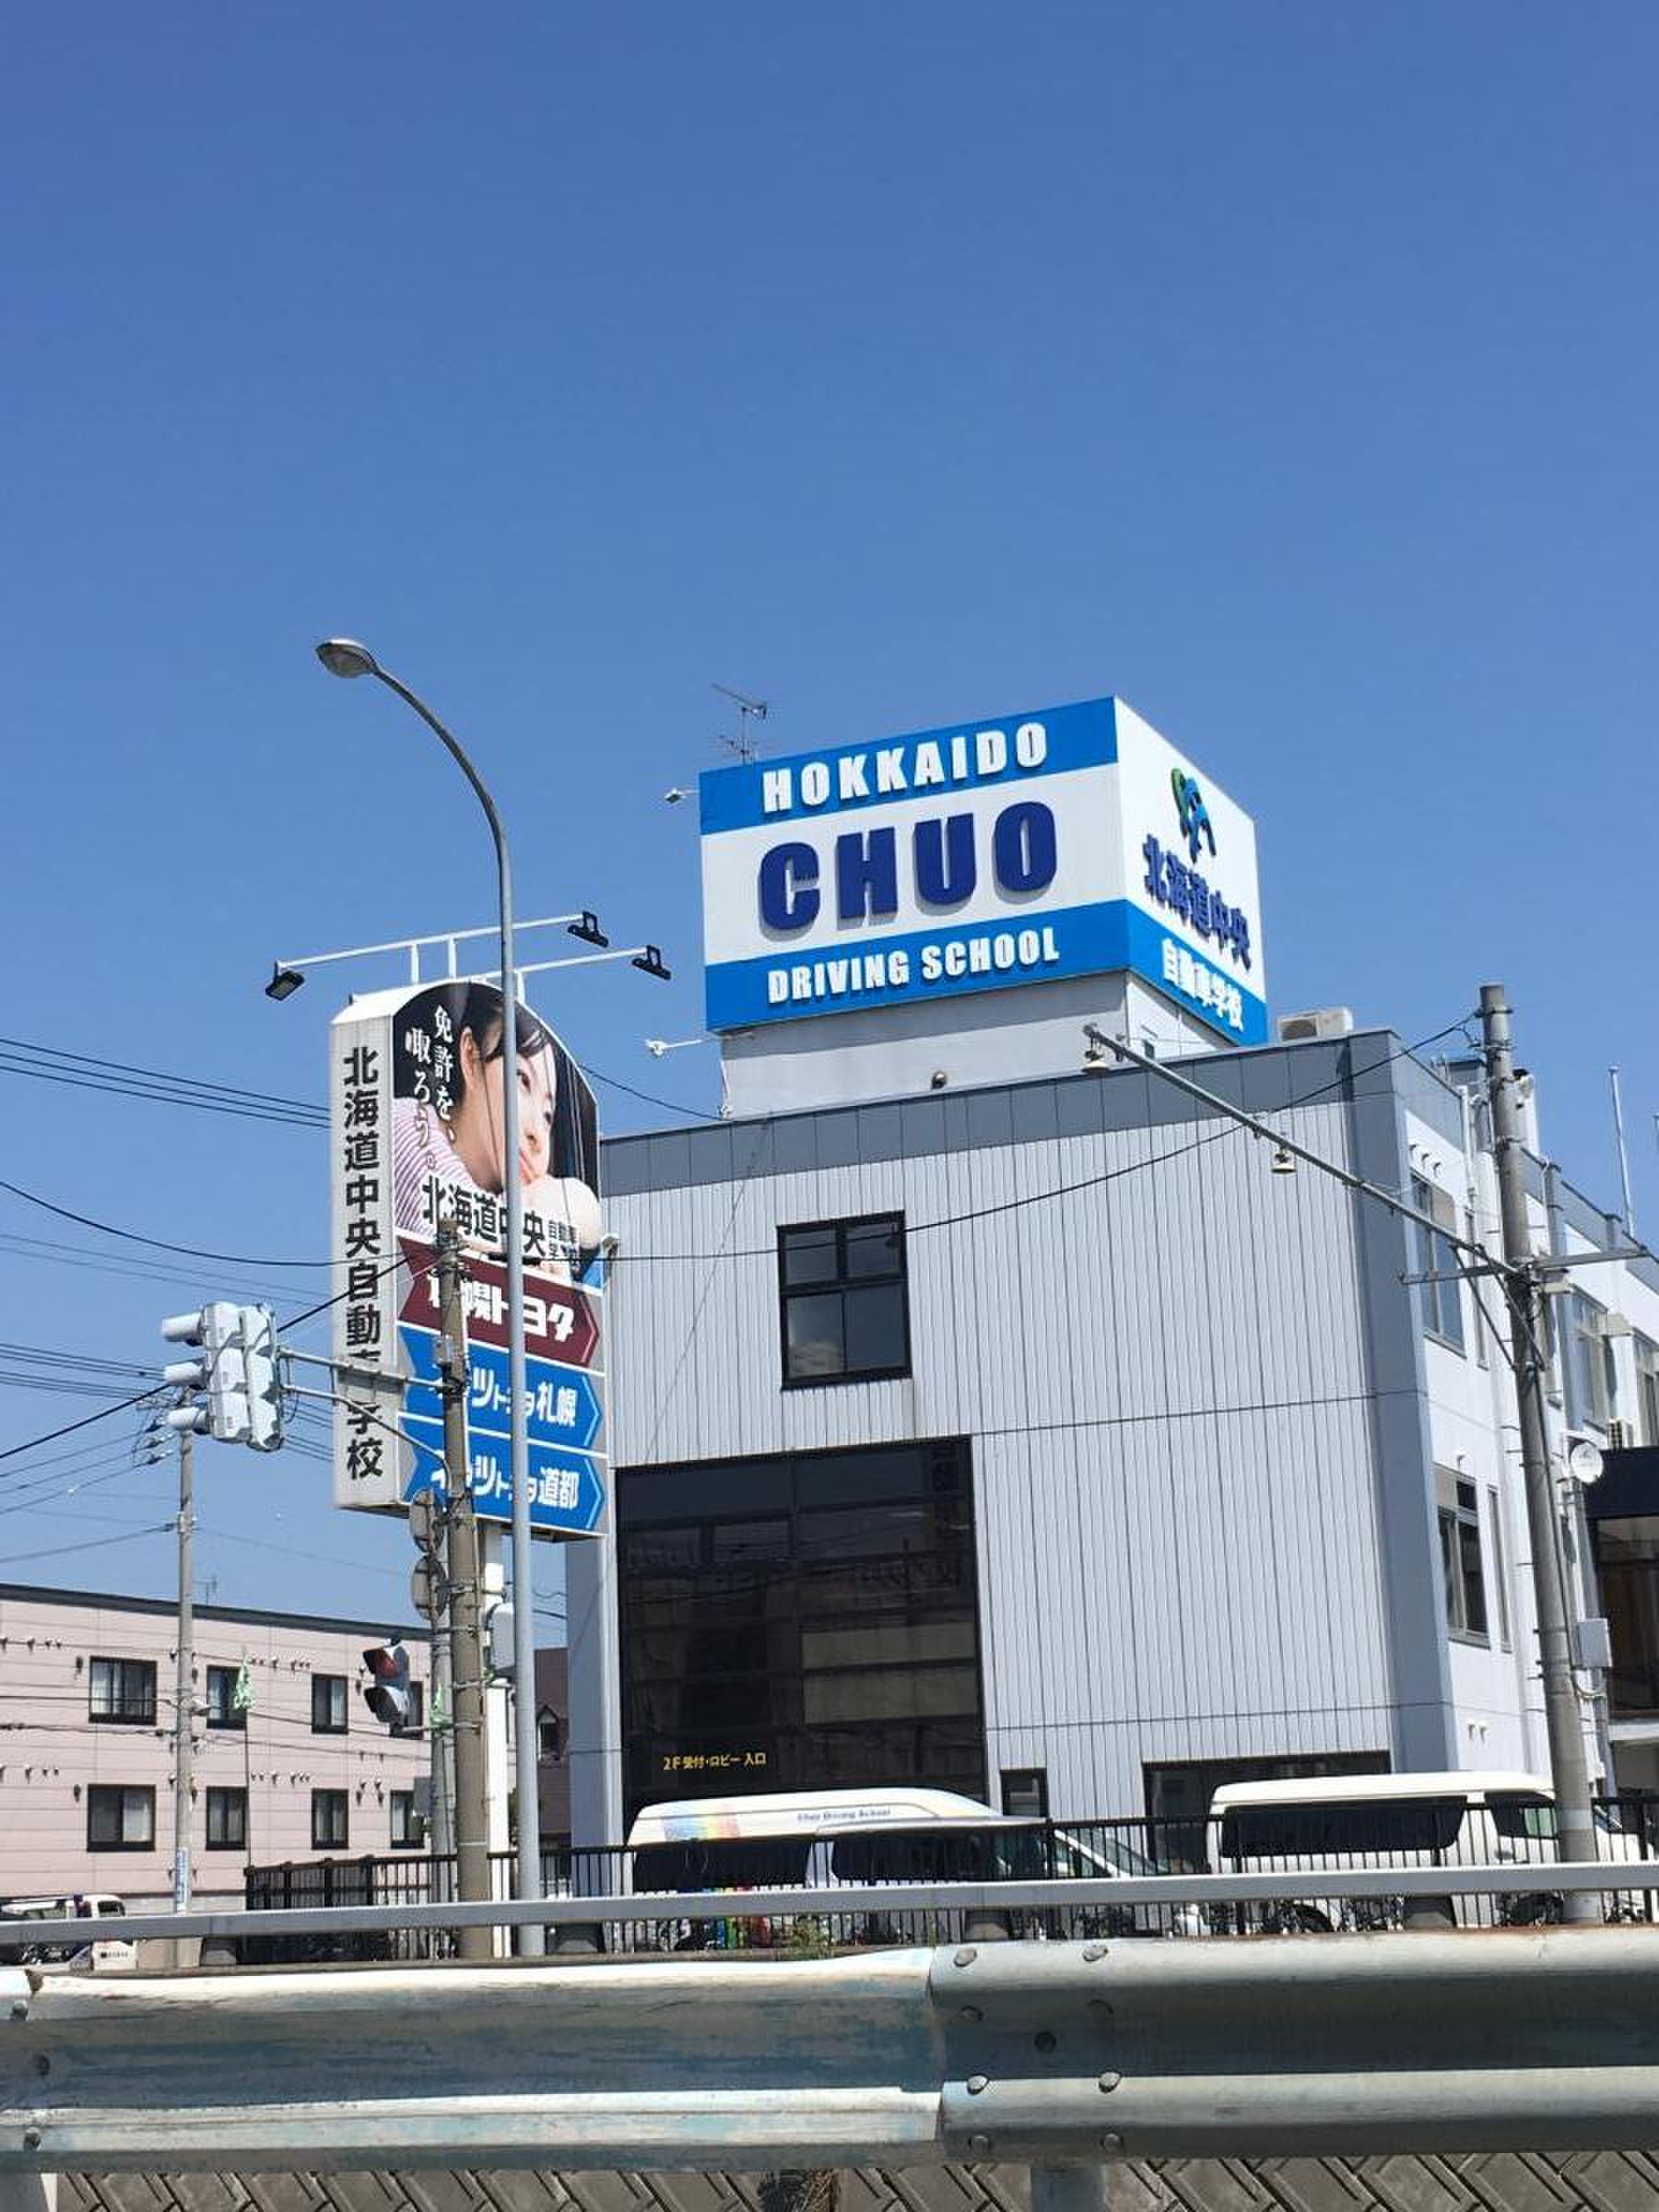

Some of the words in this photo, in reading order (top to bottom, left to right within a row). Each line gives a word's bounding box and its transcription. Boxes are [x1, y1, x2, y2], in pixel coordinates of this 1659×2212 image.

[762, 722, 1048, 812] HOKKAIDO
[760, 801, 1057, 931] CHUO
[1143, 834, 1251, 971] 北海道中央
[768, 949, 909, 1004] DRIVING
[922, 926, 1059, 982] SCHOOL
[344, 1046, 383, 1480] 北海道中央自動学校
[422, 1175, 546, 1258] 北海道央
